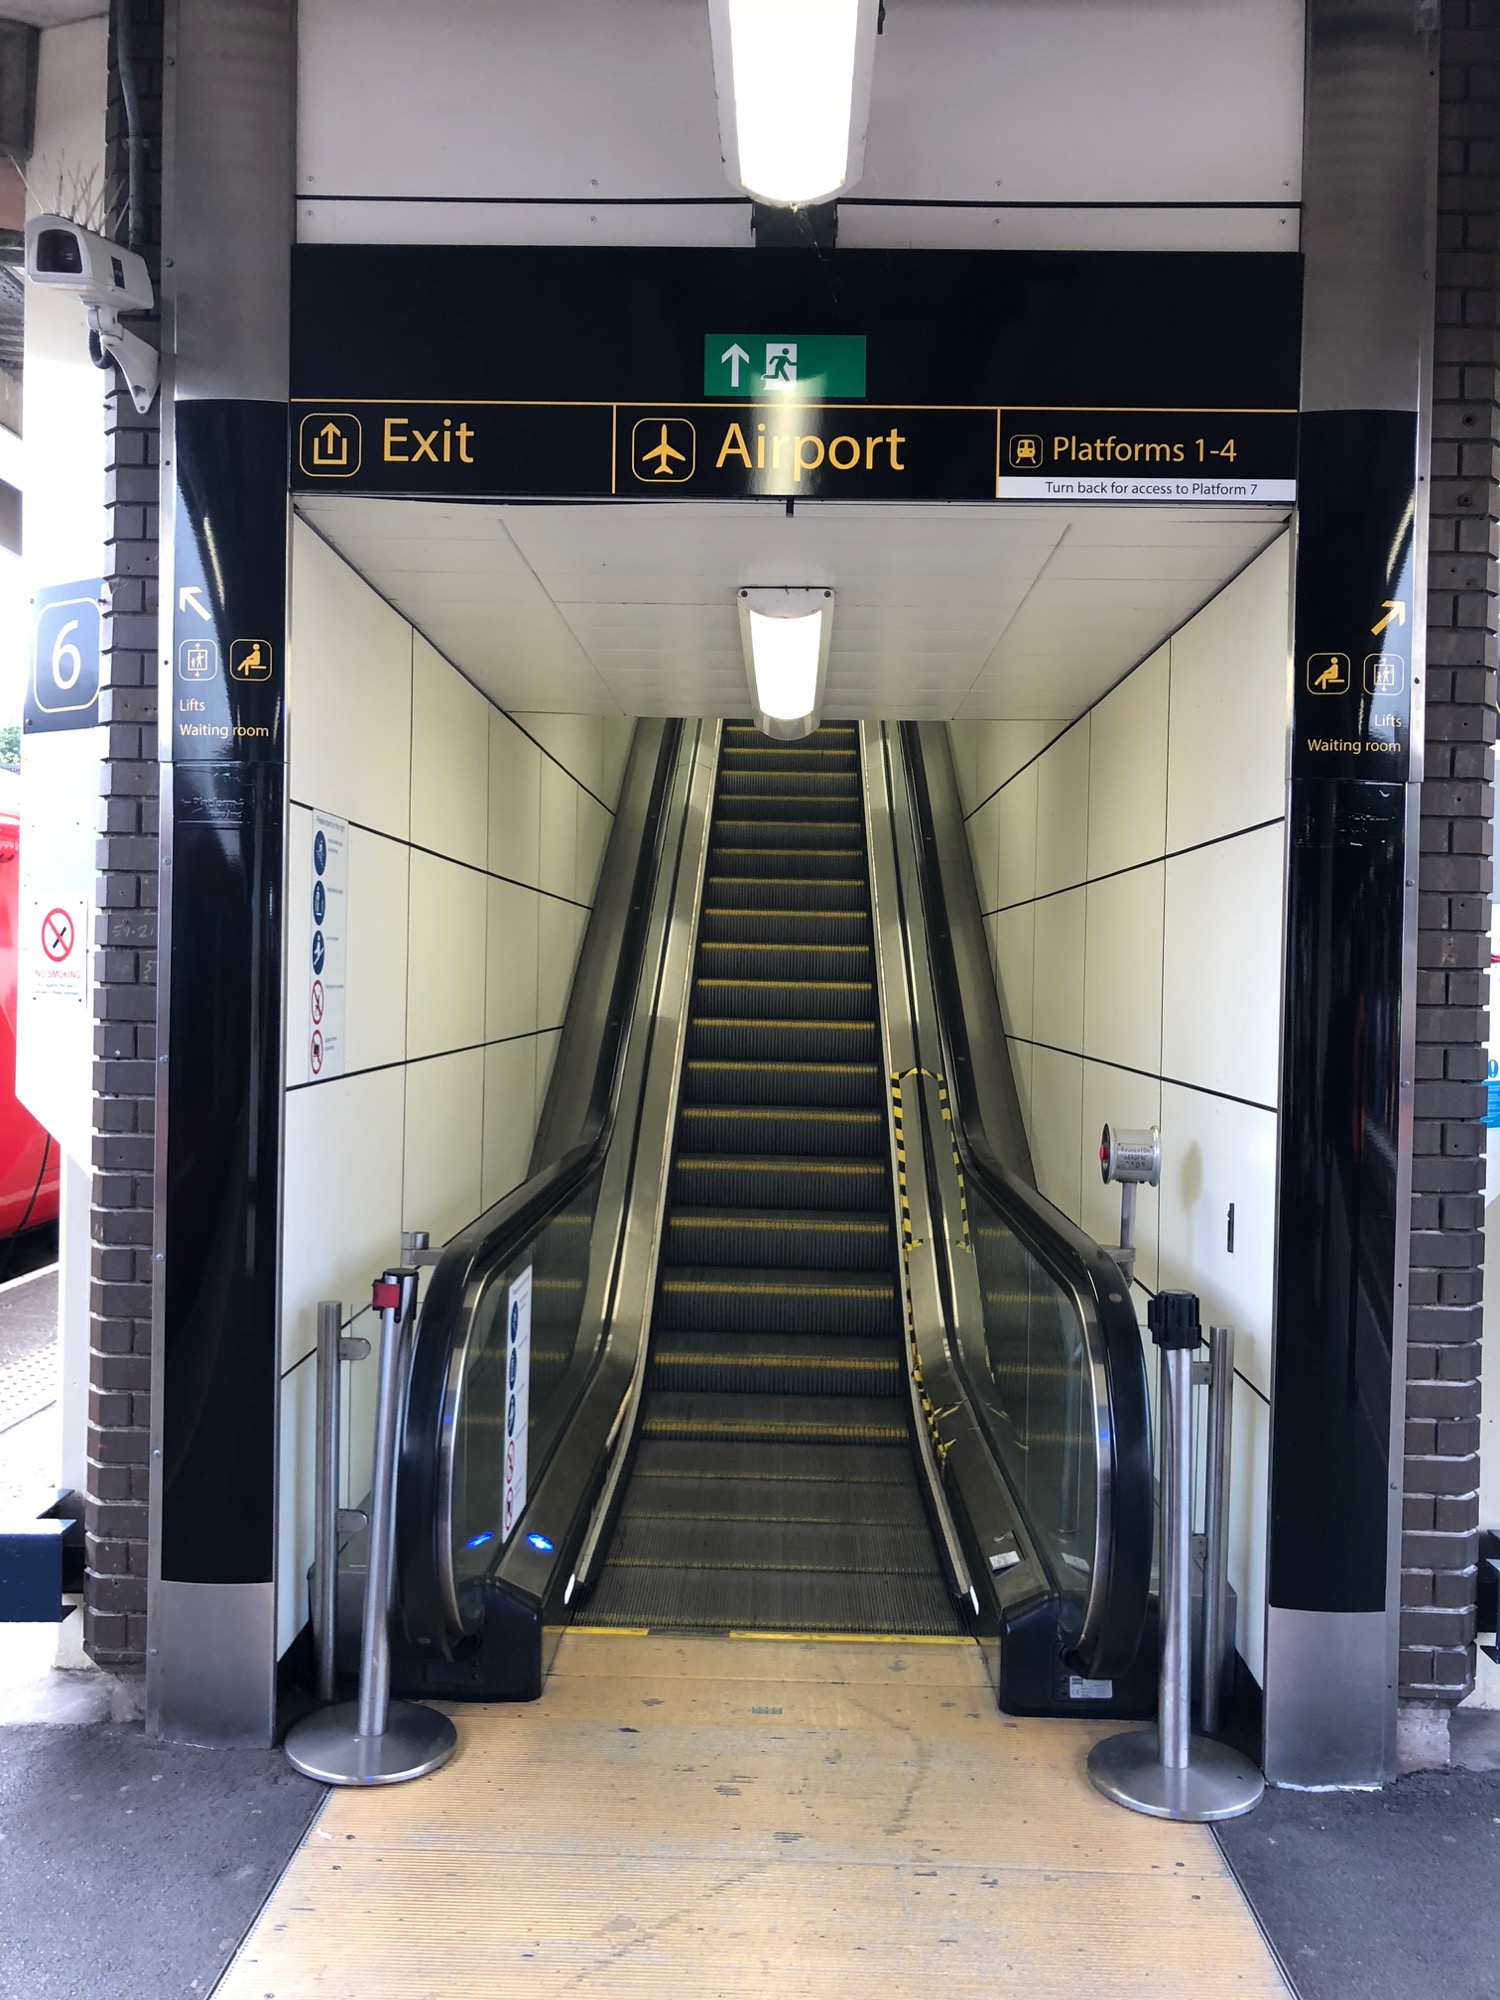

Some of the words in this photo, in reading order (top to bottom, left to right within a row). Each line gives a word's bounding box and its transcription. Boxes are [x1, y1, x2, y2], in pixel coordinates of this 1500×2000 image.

[383, 417, 475, 465] Exit
[1053, 435, 1185, 463] Platforms
[1195, 438, 1237, 463] 1-4
[715, 421, 906, 482] Airport
[1045, 481, 1074, 493] Turn
[1077, 481, 1107, 493] back
[1111, 481, 1128, 494] for
[1131, 484, 1172, 494] access
[1176, 484, 1189, 494] to
[1192, 482, 1246, 495] Platform
[1250, 484, 1258, 495] 7
[53, 619, 81, 689] 6
[180, 698, 205, 712] Lifts
[1374, 713, 1402, 727] Lifts
[180, 723, 229, 739] Waiting
[232, 726, 270, 737] room
[1307, 739, 1362, 755] Waiting
[1365, 741, 1401, 752] room
[35, 969, 46, 978] NO
[47, 970, 81, 980] SMOKING
